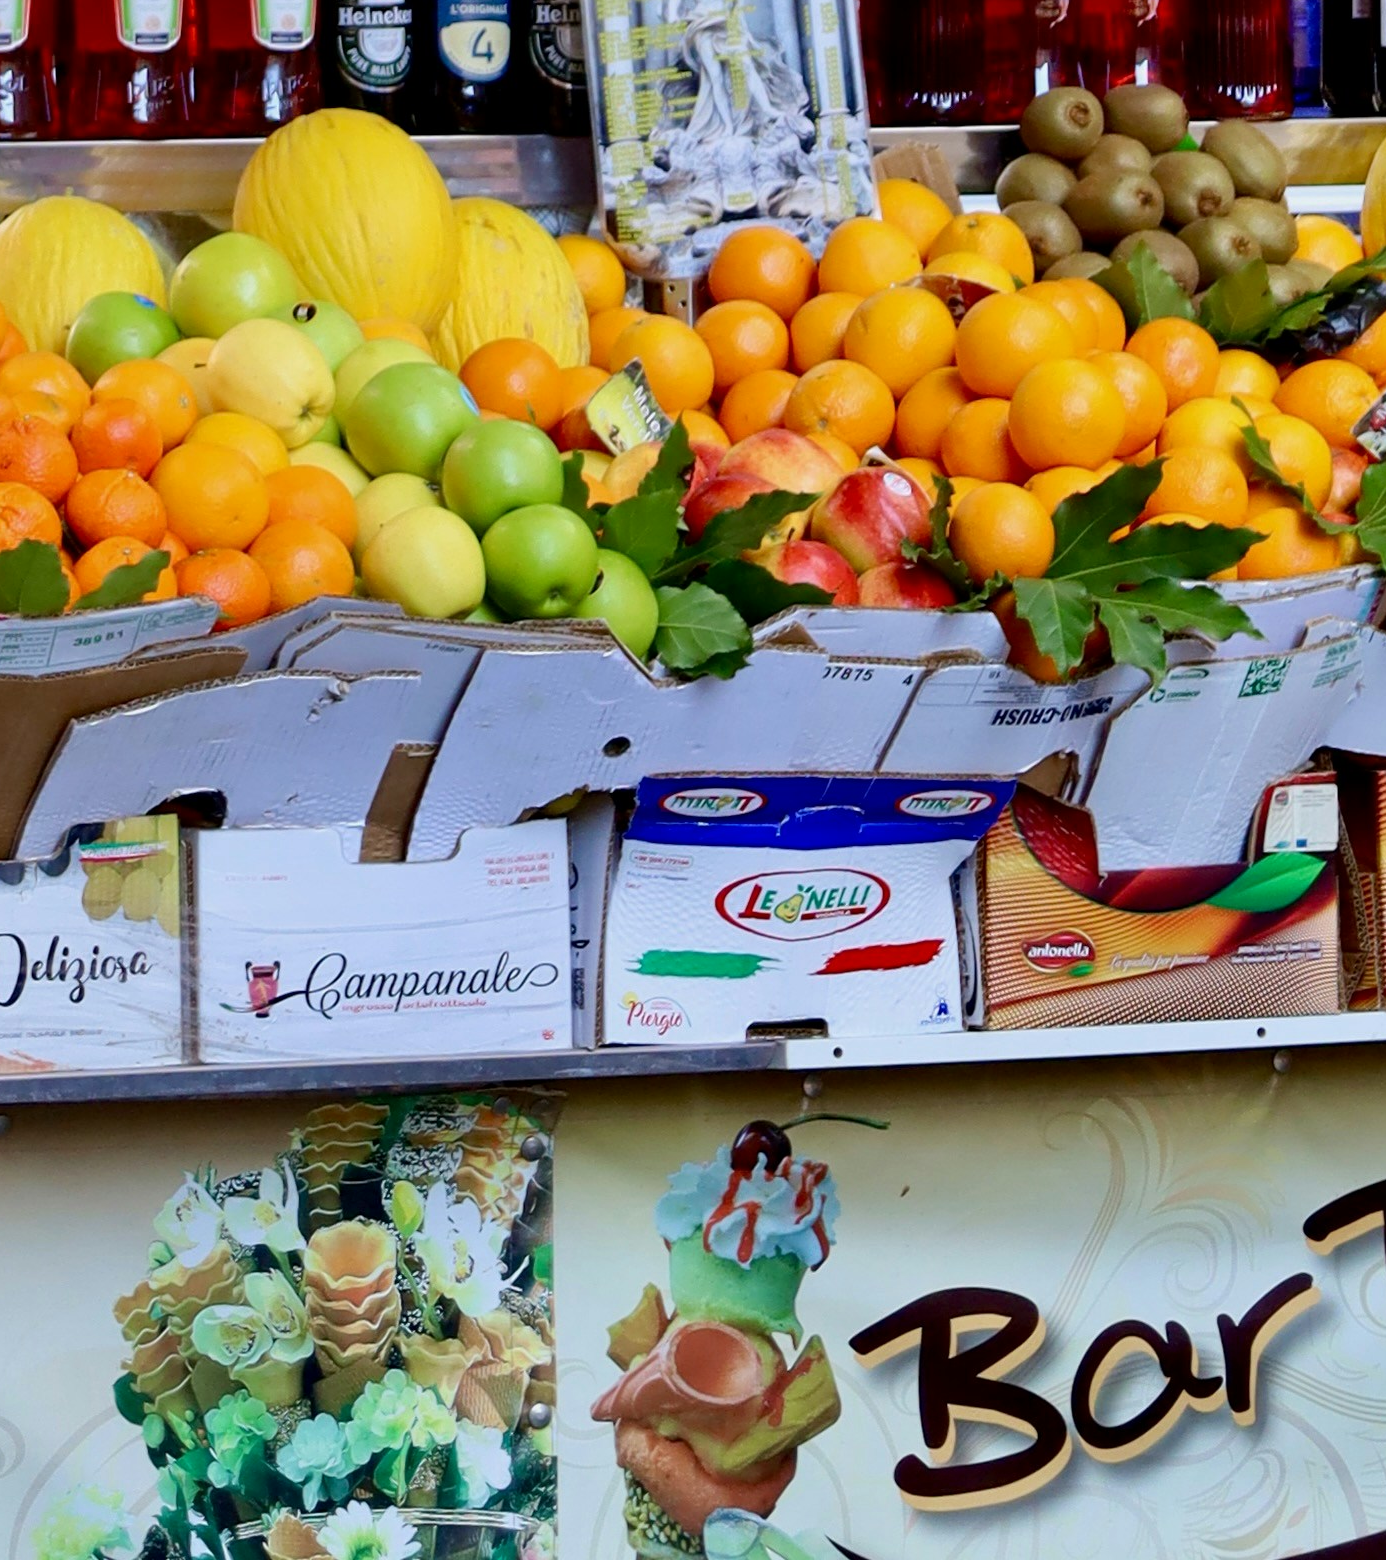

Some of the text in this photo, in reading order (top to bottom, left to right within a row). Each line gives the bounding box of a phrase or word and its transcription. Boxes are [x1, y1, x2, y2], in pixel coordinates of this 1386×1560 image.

[338, 6, 412, 26] Heineke
[471, 26, 495, 63] 4
[989, 701, 1087, 728] NO-CRUSH
[1027, 941, 1090, 960] antonella
[304, 950, 560, 1020] Campanale
[849, 1271, 1320, 1514] Bar
